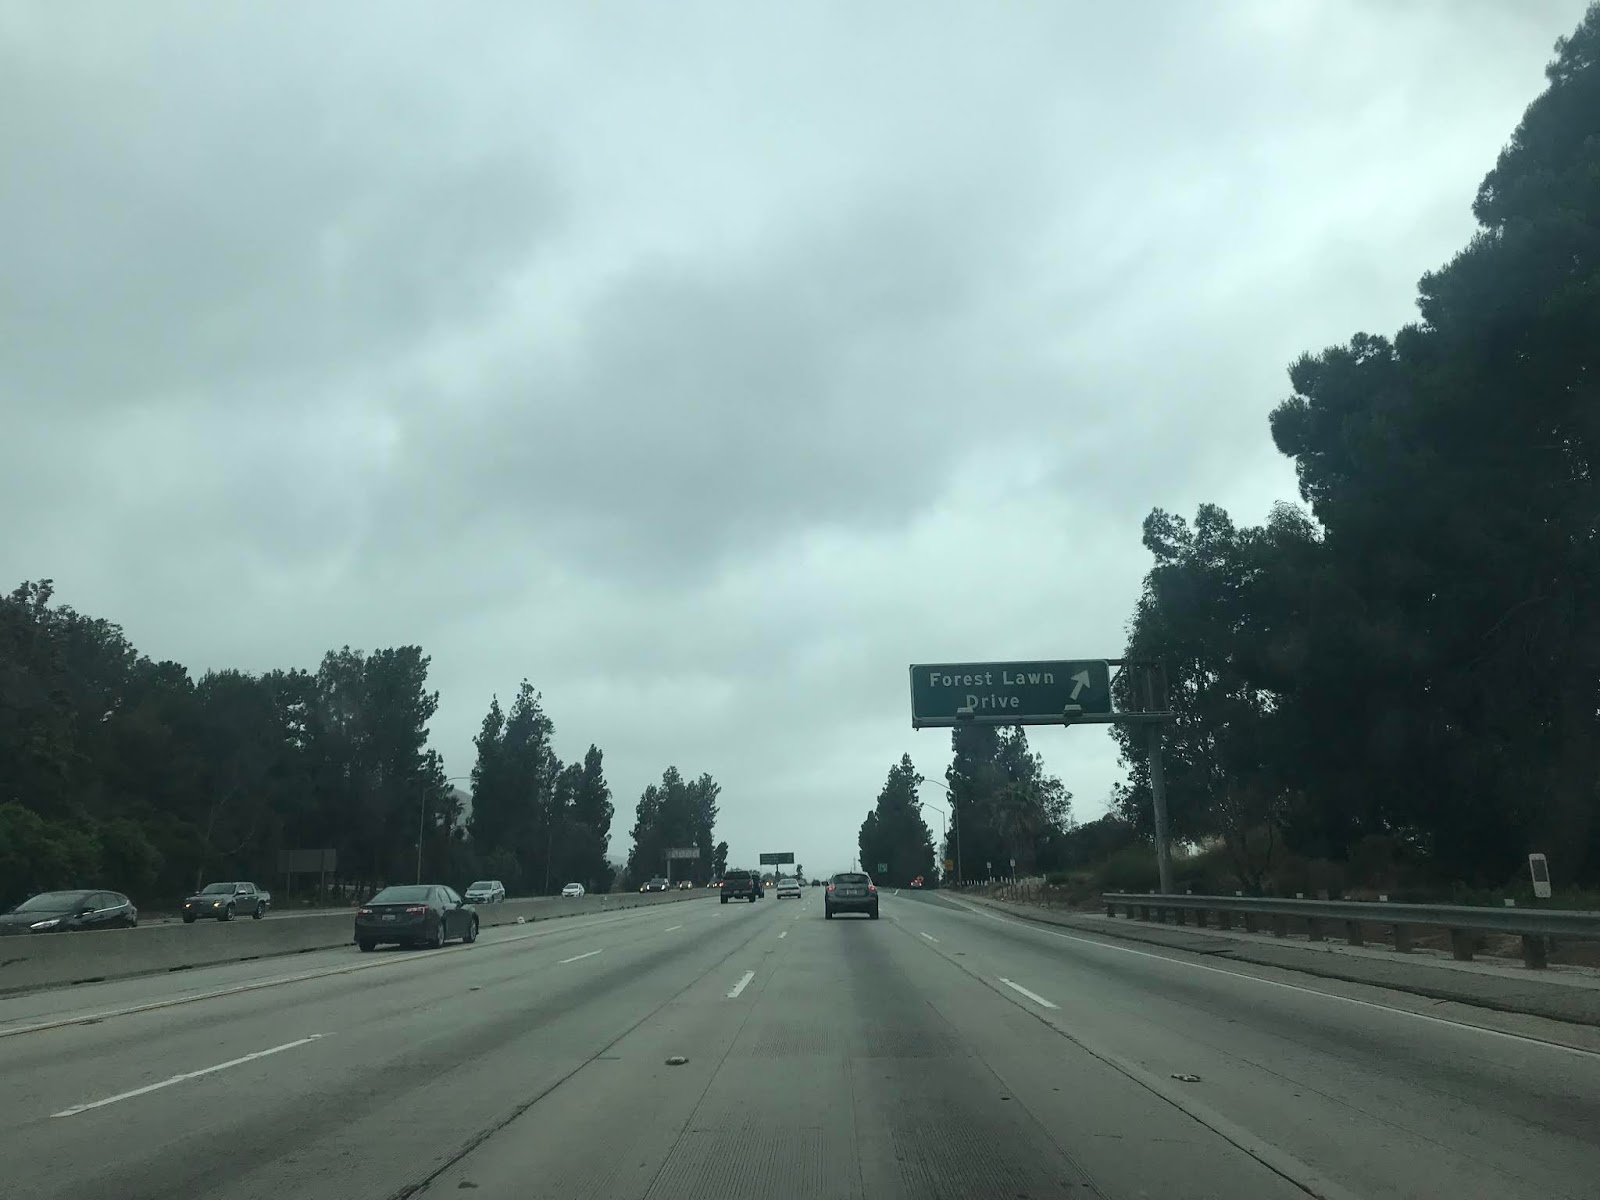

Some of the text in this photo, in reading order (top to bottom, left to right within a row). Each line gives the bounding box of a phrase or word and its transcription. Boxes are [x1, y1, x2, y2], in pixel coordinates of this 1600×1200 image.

[929, 670, 1054, 687] Forest Lawn
[965, 693, 1020, 709] Drive
